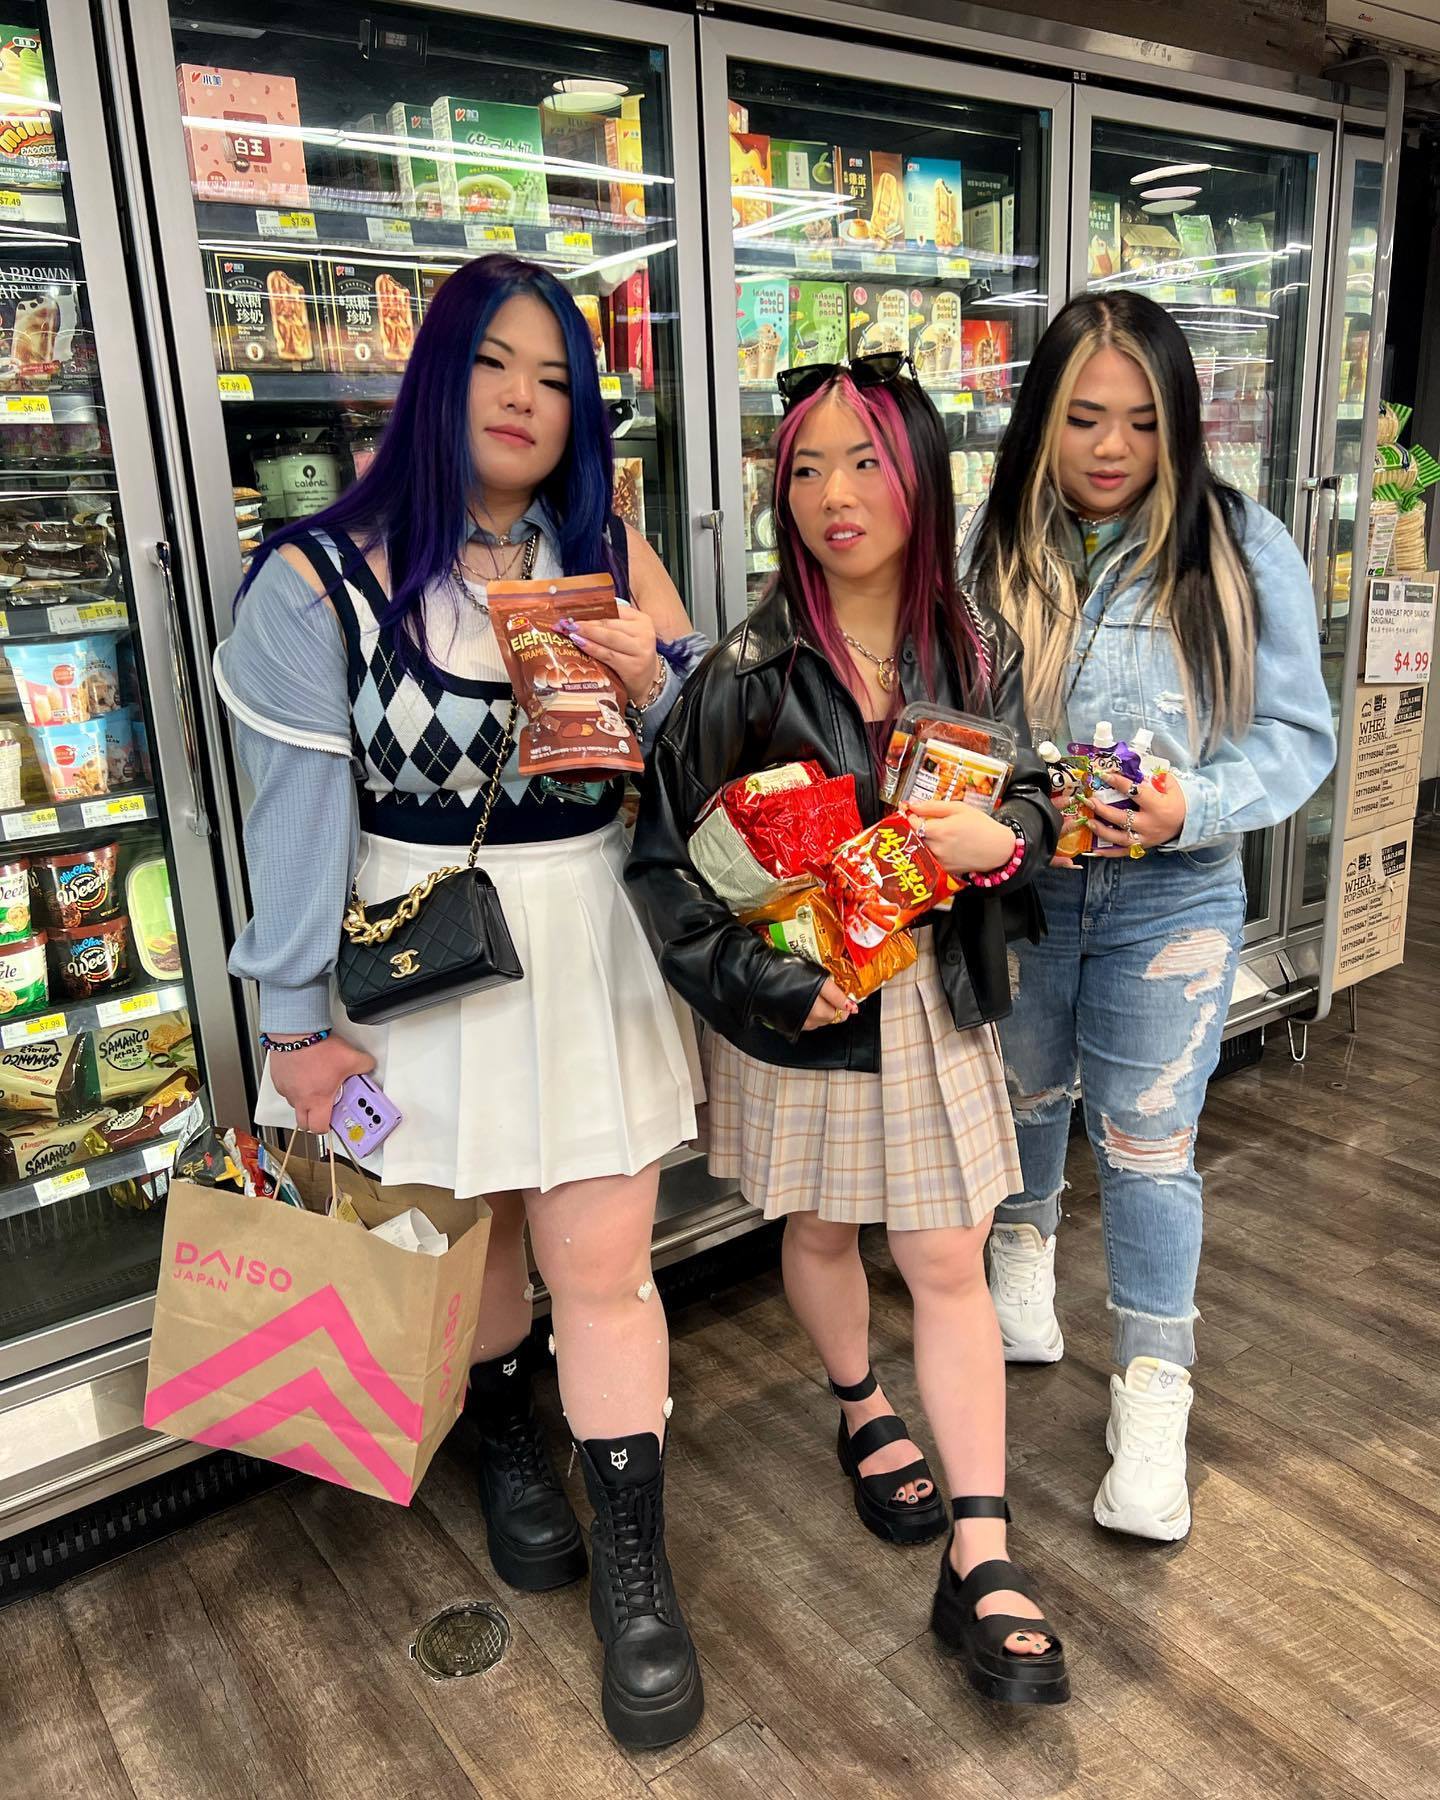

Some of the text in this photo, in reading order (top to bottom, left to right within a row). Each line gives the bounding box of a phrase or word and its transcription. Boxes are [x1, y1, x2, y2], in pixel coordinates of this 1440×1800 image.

[10, 267, 71, 282] BROWN
[1394, 649, 1429, 676] $4.99
[56, 869, 110, 905] Weezle
[98, 1029, 149, 1059] SAMANCO
[2, 1051, 62, 1068] SAMANCO
[25, 1141, 76, 1176] SAMANCO
[172, 1268, 229, 1293] JAPAN
[174, 1241, 293, 1293] DAISO
